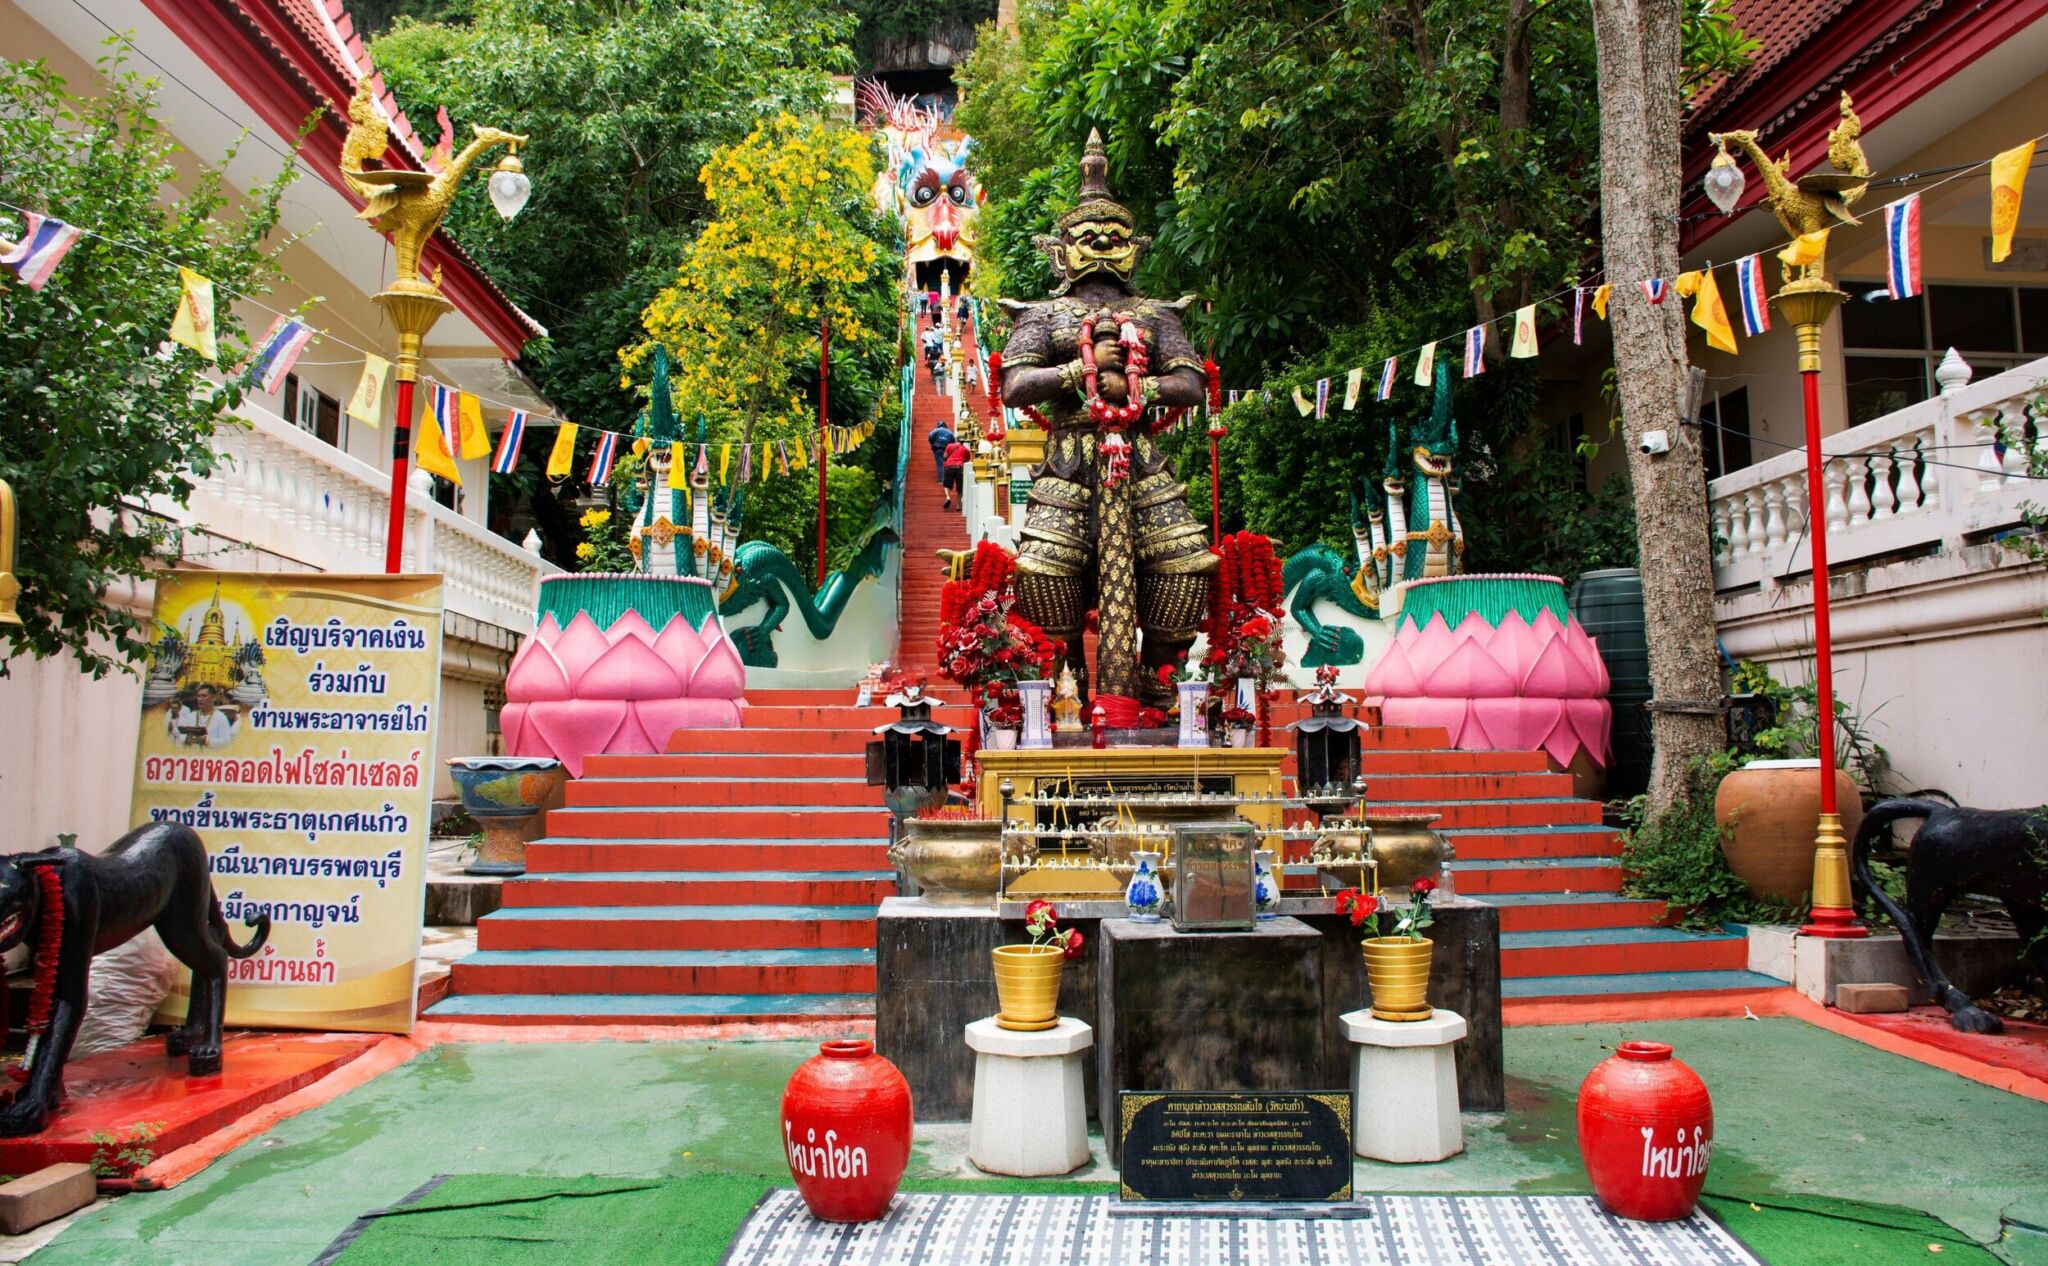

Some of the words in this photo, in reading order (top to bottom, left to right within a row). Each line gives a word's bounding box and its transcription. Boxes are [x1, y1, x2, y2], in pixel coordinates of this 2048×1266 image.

[265, 618, 425, 653] เชิญบริจาคเงิน
[308, 665, 386, 694] ร่วมกับ
[252, 705, 428, 732] ท่านพระอาจารย์ไก่
[145, 749, 420, 787] ถวายหลอดไฟโซล่าเซลล์
[150, 792, 408, 841] ทางขึ้นพระธาตุเกศแก้ว
[217, 891, 360, 929] มืองกาญจน์
[228, 939, 335, 984] วดบ้านถ้ำ
[785, 1119, 868, 1179] ไหนำโชค
